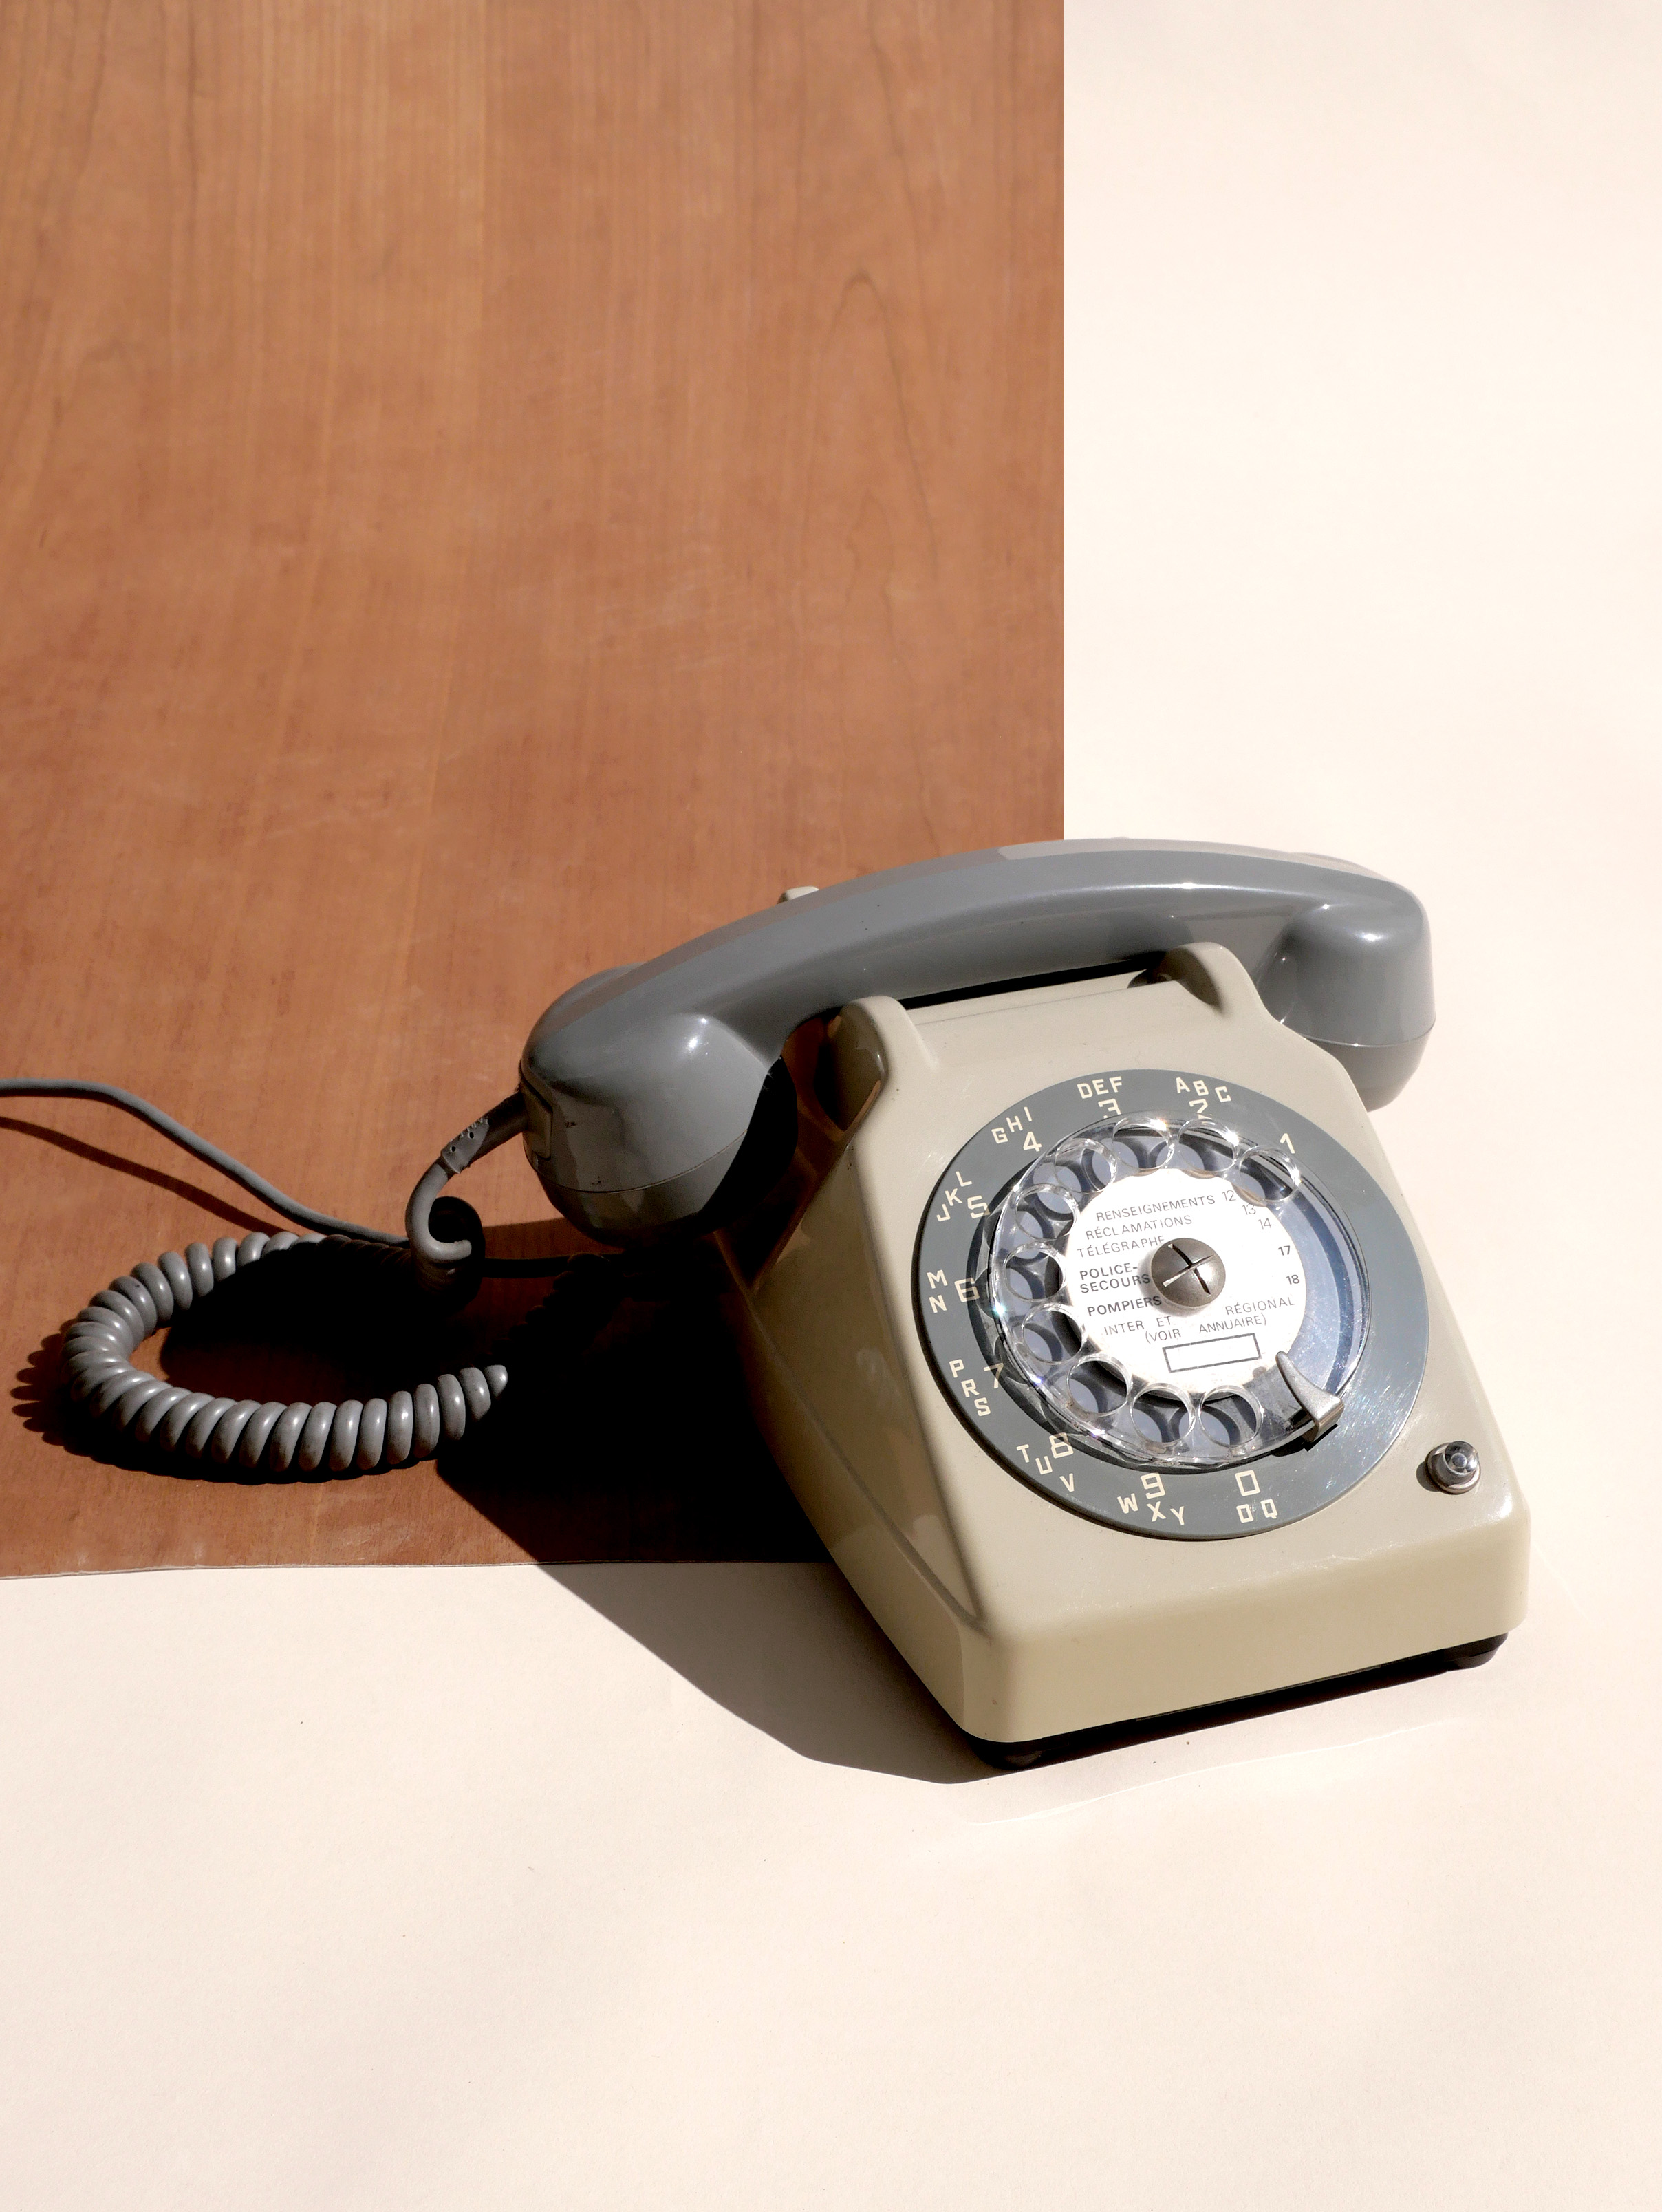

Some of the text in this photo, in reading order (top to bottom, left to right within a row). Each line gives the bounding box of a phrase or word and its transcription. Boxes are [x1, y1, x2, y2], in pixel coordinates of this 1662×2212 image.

[1077, 1076, 1123, 1099] DEF
[1175, 1077, 1232, 1103] ABC
[1097, 1098, 1122, 1119] 3
[1189, 1098, 1213, 1121] 2
[991, 1106, 1033, 1144] GHI
[1022, 1131, 1042, 1152] 4
[1280, 1132, 1296, 1155] 1
[936, 1170, 973, 1223] JKL
[967, 1195, 991, 1219] 5
[1096, 1190, 1237, 1222] RENSEIGNEMENTS 12
[1085, 1203, 1257, 1241] RÉCLAMATIONS 13
[1258, 1217, 1273, 1230] 14
[1079, 1263, 1138, 1281] POLICE-
[1080, 1245, 1291, 1294] SECOURS 17
[954, 1276, 980, 1303] 6
[1087, 1274, 1300, 1317] POMPIERS 18
[1104, 1296, 1296, 1336] INTER ET RÉGIONAL
[1145, 1313, 1267, 1345] (VOIR ANNUAIRE)
[983, 1362, 1004, 1389] 7
[1048, 1432, 1074, 1459] 8
[1140, 1472, 1166, 1499] 9
[1116, 1493, 1185, 1525] WXY
